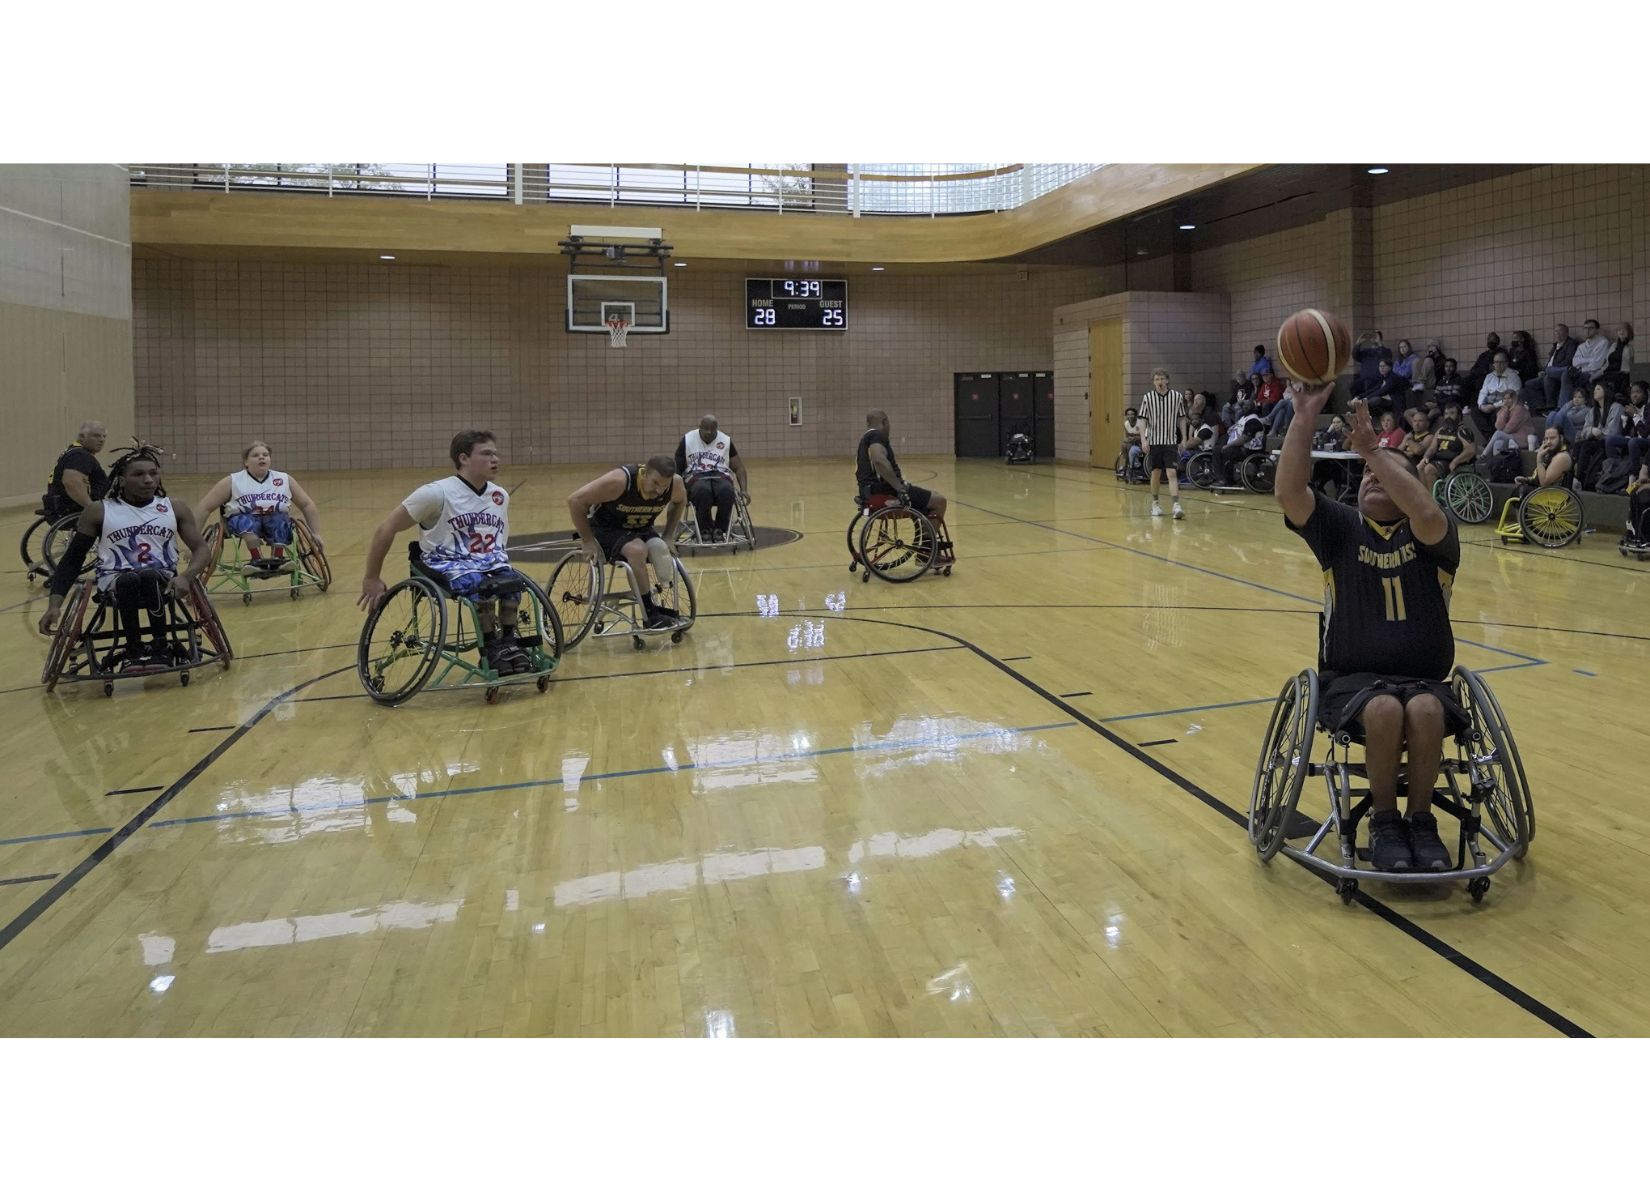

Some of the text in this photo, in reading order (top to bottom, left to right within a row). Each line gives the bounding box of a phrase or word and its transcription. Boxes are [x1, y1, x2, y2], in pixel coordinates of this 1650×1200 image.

[784, 281, 819, 297] 9:39
[820, 300, 843, 308] GUEST
[754, 308, 776, 325] 28
[822, 309, 843, 325] 25
[469, 532, 496, 553] 22
[137, 543, 152, 564] 2
[1381, 576, 1407, 621] 11
